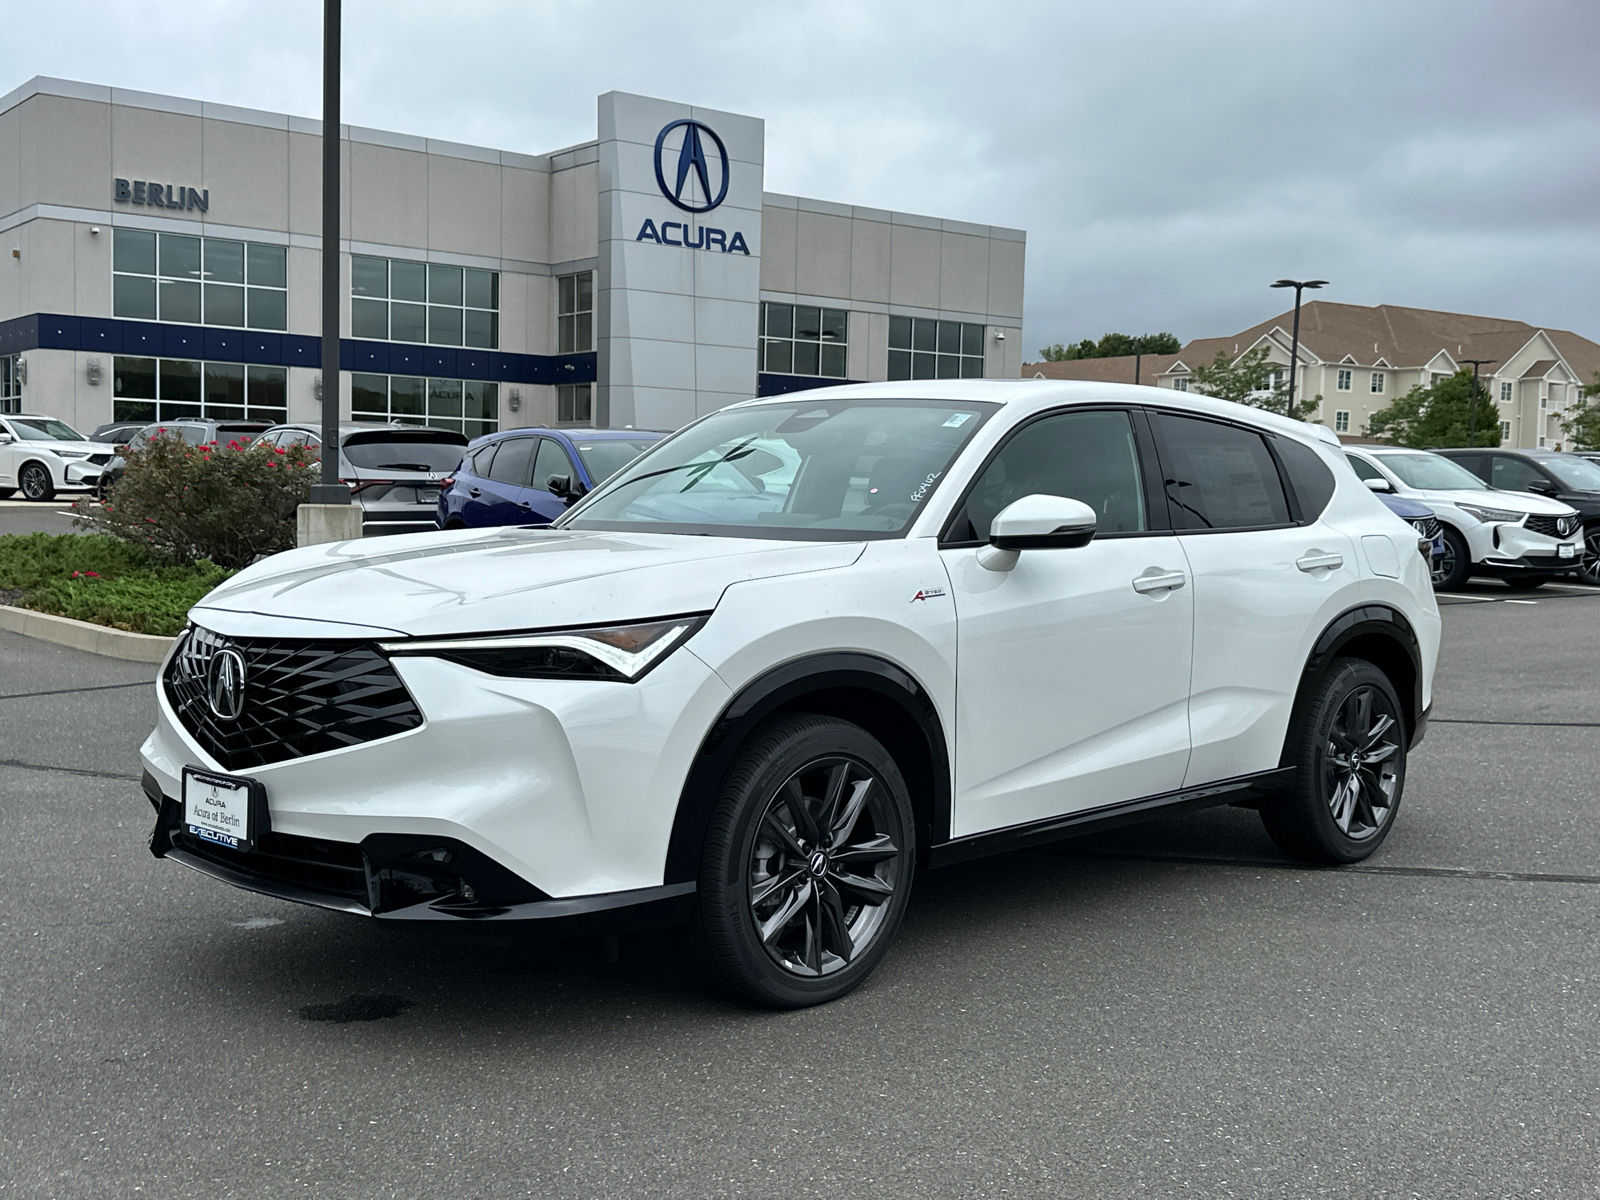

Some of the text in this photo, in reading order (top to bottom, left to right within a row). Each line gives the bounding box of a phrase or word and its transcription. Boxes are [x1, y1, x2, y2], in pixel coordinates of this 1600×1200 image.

[114, 178, 209, 212] BERLIN
[636, 218, 750, 256] ACURA
[205, 797, 226, 809] ACURA
[193, 804, 240, 828] Acura of Berlin
[189, 825, 239, 846] EXECUTIVE
